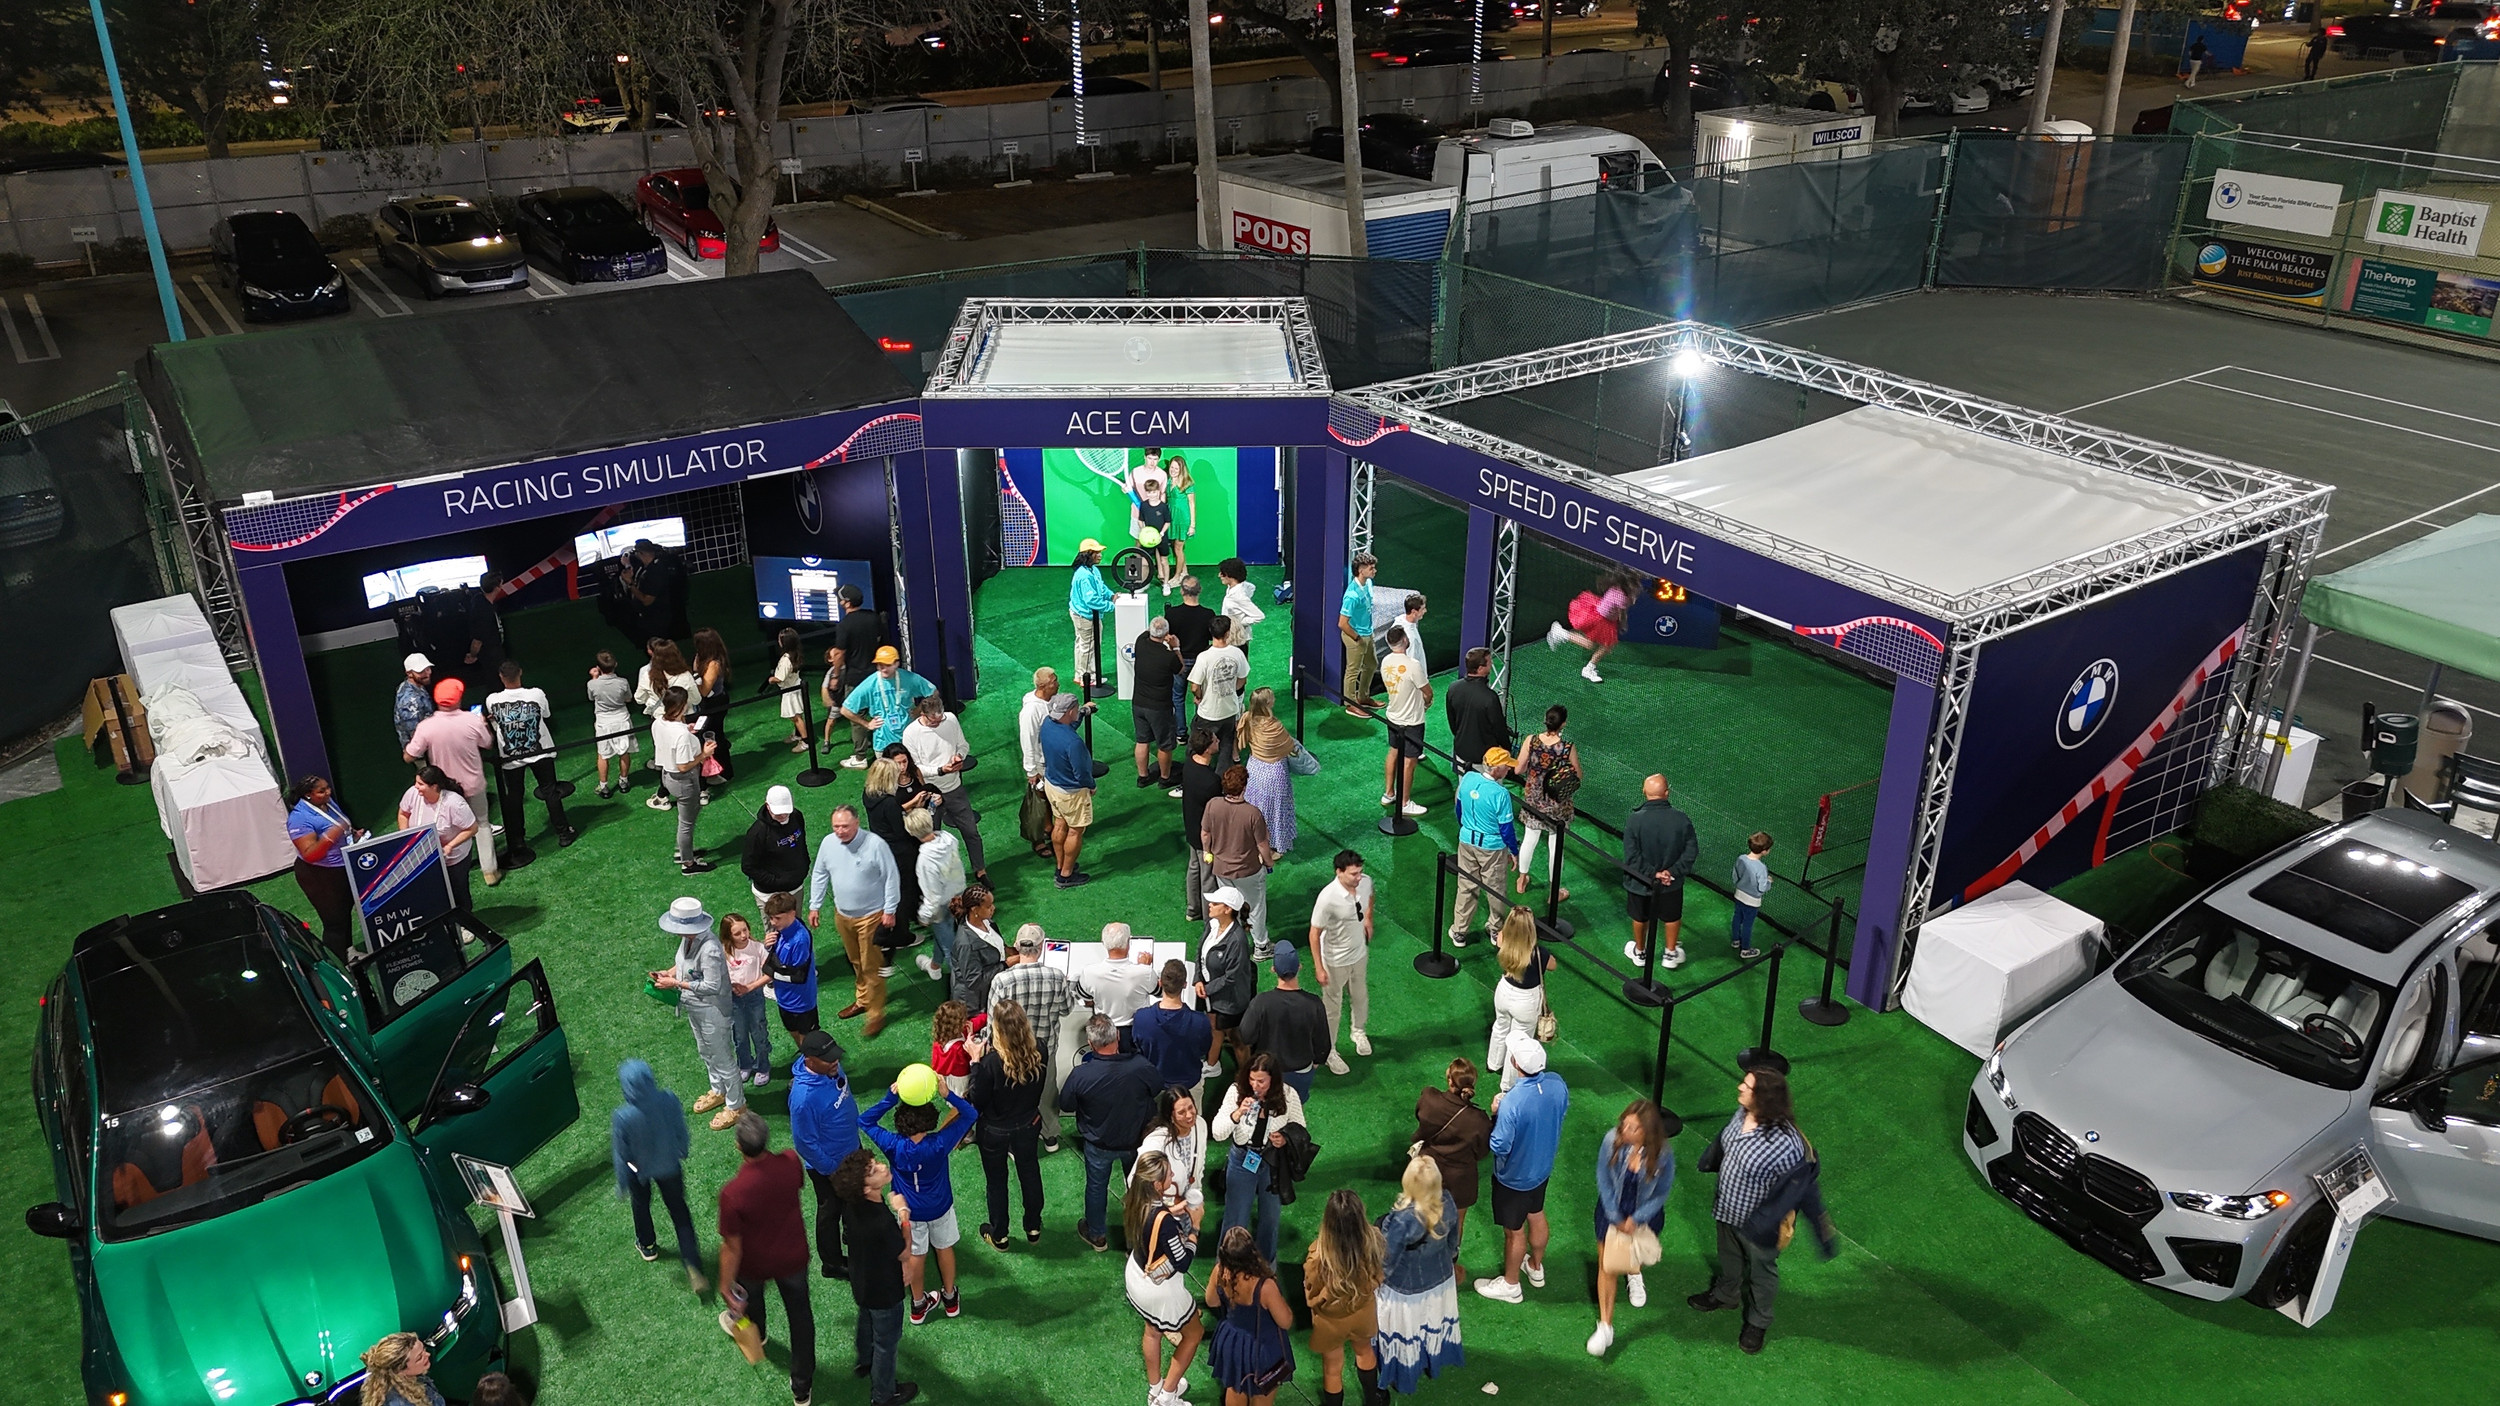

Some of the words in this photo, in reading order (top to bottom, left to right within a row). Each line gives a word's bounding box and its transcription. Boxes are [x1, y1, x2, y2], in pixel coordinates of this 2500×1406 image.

[1815, 128, 1860, 144] WILLSCOT
[2247, 199, 2284, 209] BMWSFL.com
[2278, 197, 2296, 205] Florida
[2312, 202, 2333, 210] Centers
[2419, 206, 2477, 227] Baptist
[1235, 215, 1308, 255] PODS
[2414, 224, 2468, 246] Health
[2231, 254, 2251, 266] THE
[2253, 260, 2279, 272] PALM
[2281, 264, 2327, 279] BEACHES
[2247, 247, 2297, 264] WELCOME
[2299, 254, 2314, 266] TO
[2364, 268, 2383, 281] The
[2384, 272, 2417, 288] Pomp
[1066, 411, 1122, 435] ACE
[1130, 410, 1190, 435] CAM
[443, 472, 573, 518] RACING
[582, 439, 768, 494] SIMULATOR
[1478, 468, 1556, 520] SPEED
[1563, 500, 1600, 534] OF
[1604, 515, 1696, 574] SERVE
[2072, 663, 2115, 696] BMW
[374, 907, 411, 926] BMW
[105, 1117, 119, 1129] 15
